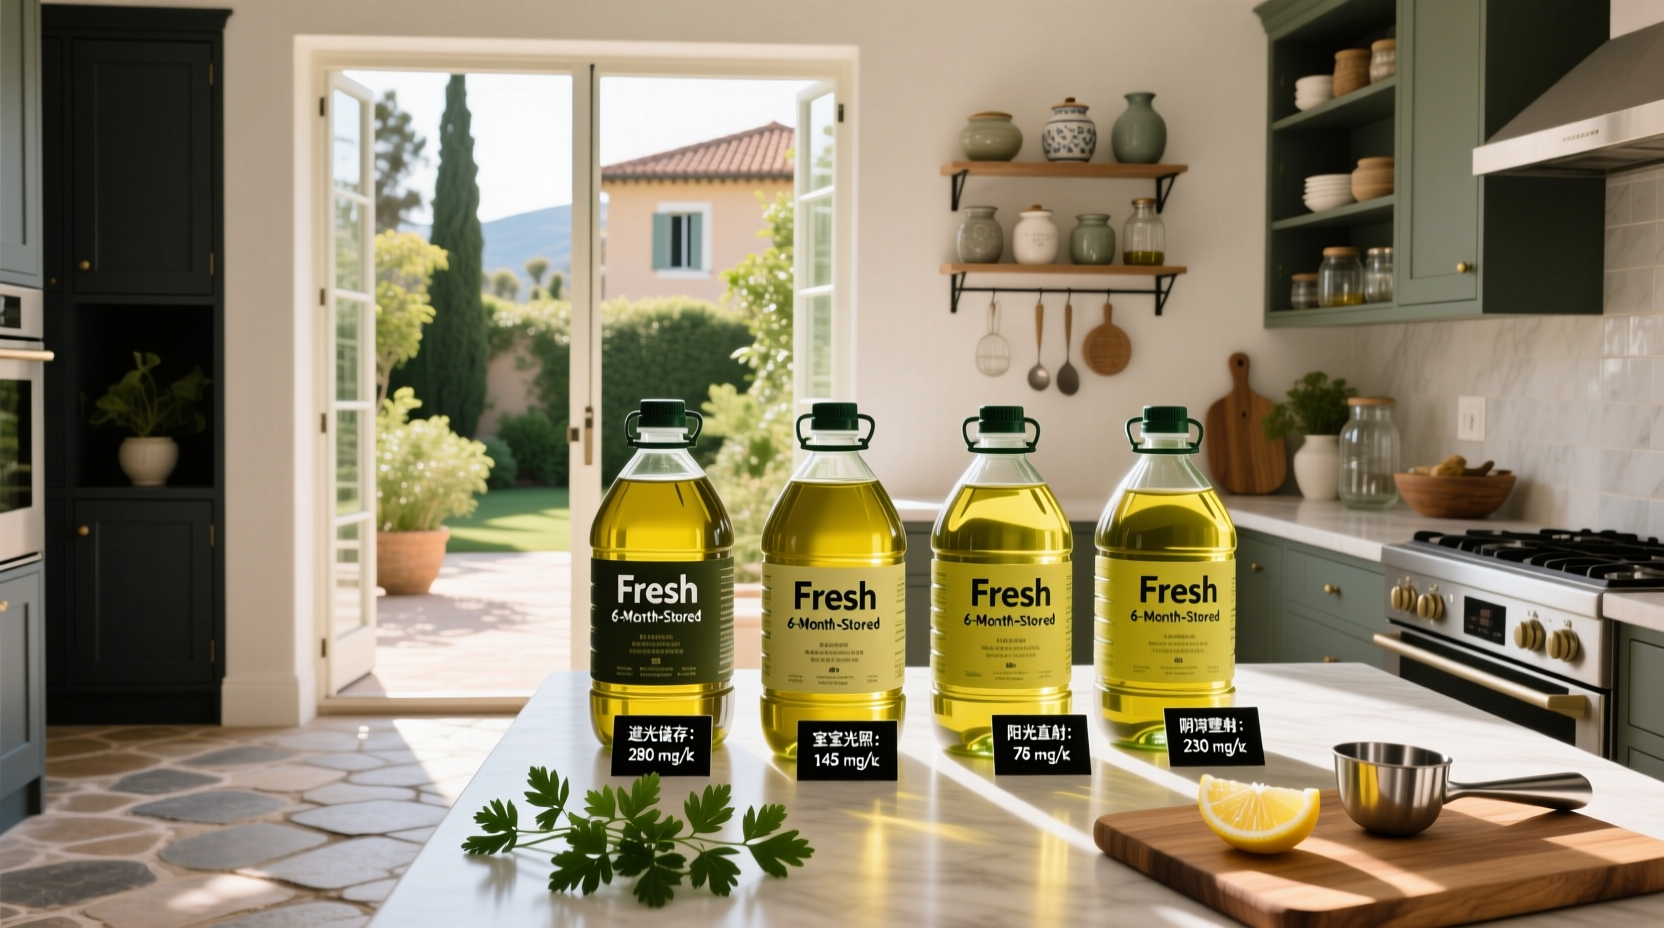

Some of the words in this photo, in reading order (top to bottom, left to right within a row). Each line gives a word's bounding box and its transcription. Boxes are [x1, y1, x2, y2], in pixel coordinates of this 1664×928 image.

[617, 573, 698, 605] Fresh
[794, 580, 877, 611] Fresh
[971, 577, 1051, 608] Fresh
[1139, 575, 1217, 604] Fresh
[787, 616, 880, 631] 6-Month-Stored
[963, 612, 1055, 627] 6-Month-Stored
[1130, 609, 1220, 623] 6-Month-Stored
[1183, 738, 1209, 753] 230
[628, 747, 655, 762] 280
[814, 752, 840, 767] 145
